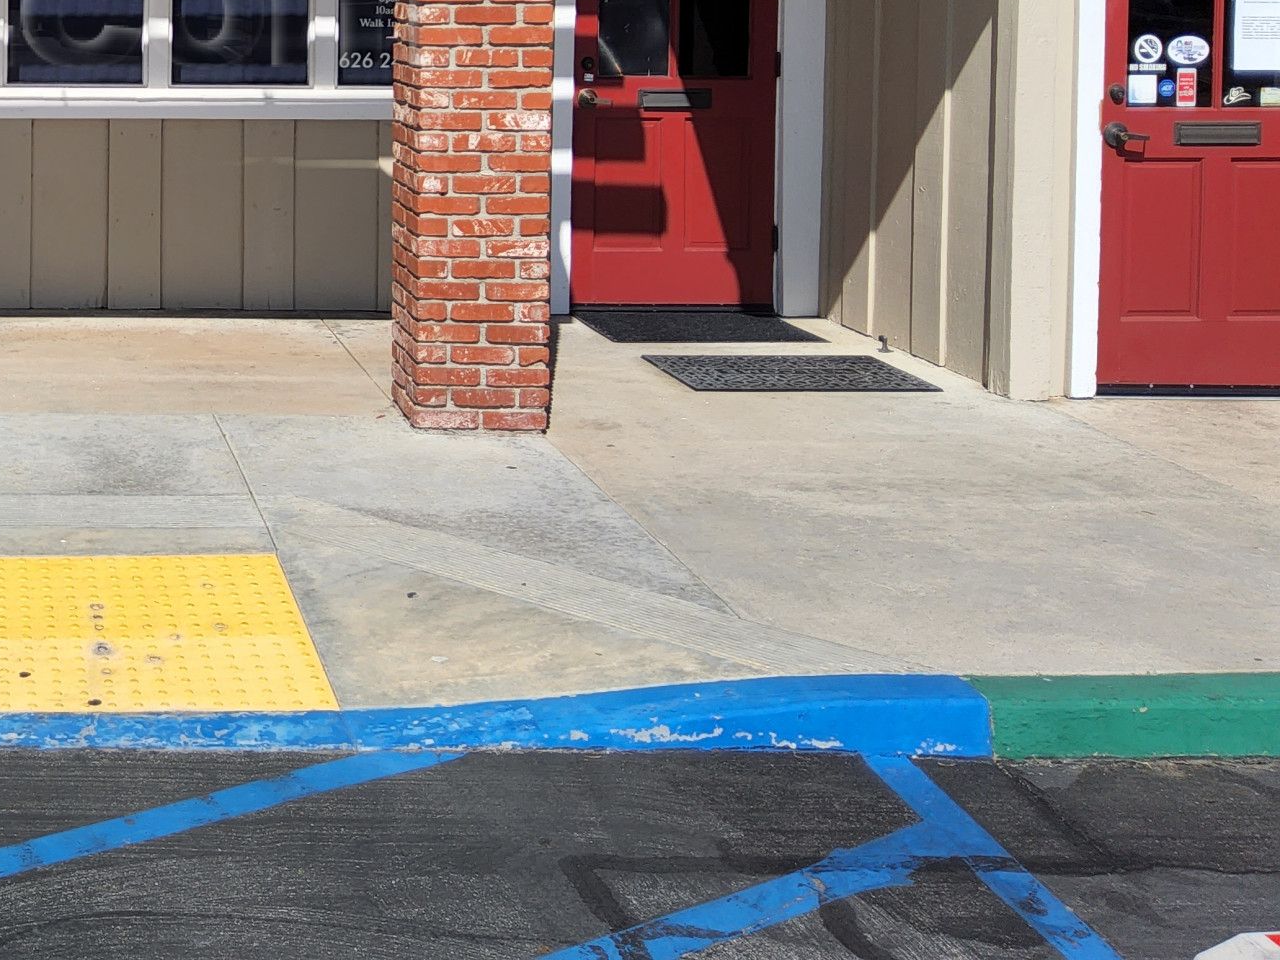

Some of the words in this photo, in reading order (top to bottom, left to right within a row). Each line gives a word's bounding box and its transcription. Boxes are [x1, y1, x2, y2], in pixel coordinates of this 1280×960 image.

[375, 5, 395, 15] 10a
[359, 18, 385, 28] Walk
[339, 51, 374, 69] 626
